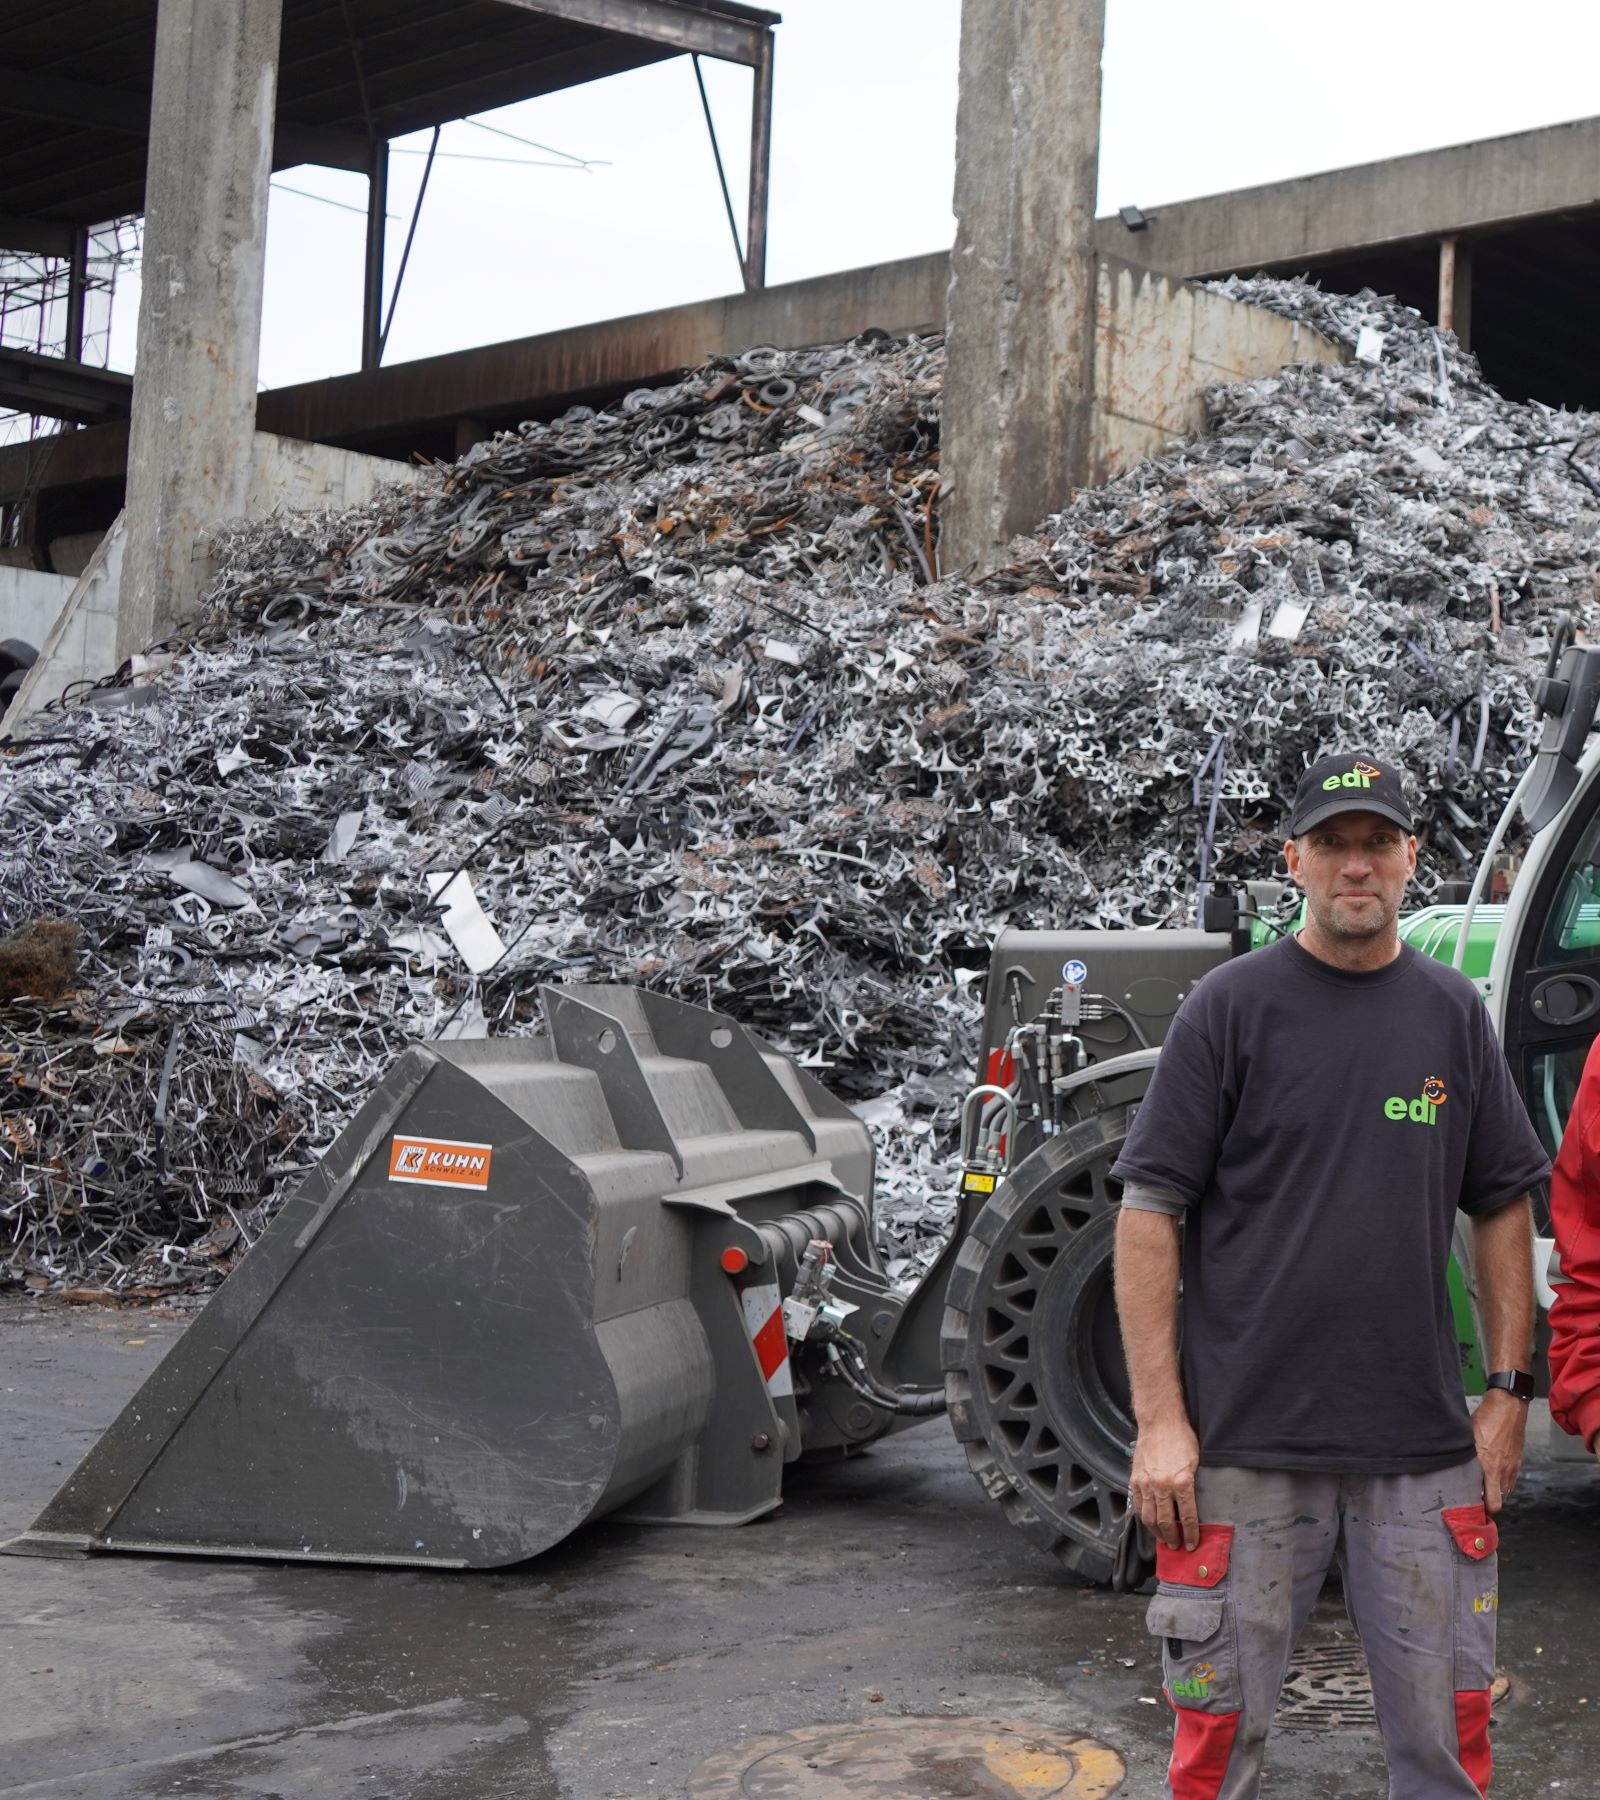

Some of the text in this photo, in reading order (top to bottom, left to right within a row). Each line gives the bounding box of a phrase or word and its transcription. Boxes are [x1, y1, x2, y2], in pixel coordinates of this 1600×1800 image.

[1322, 767, 1371, 791] edi
[1384, 1091, 1437, 1125] edi
[423, 1166, 466, 1176] SCHWEIZ
[427, 1151, 486, 1170] KUHN
[1171, 1674, 1208, 1698] edi
